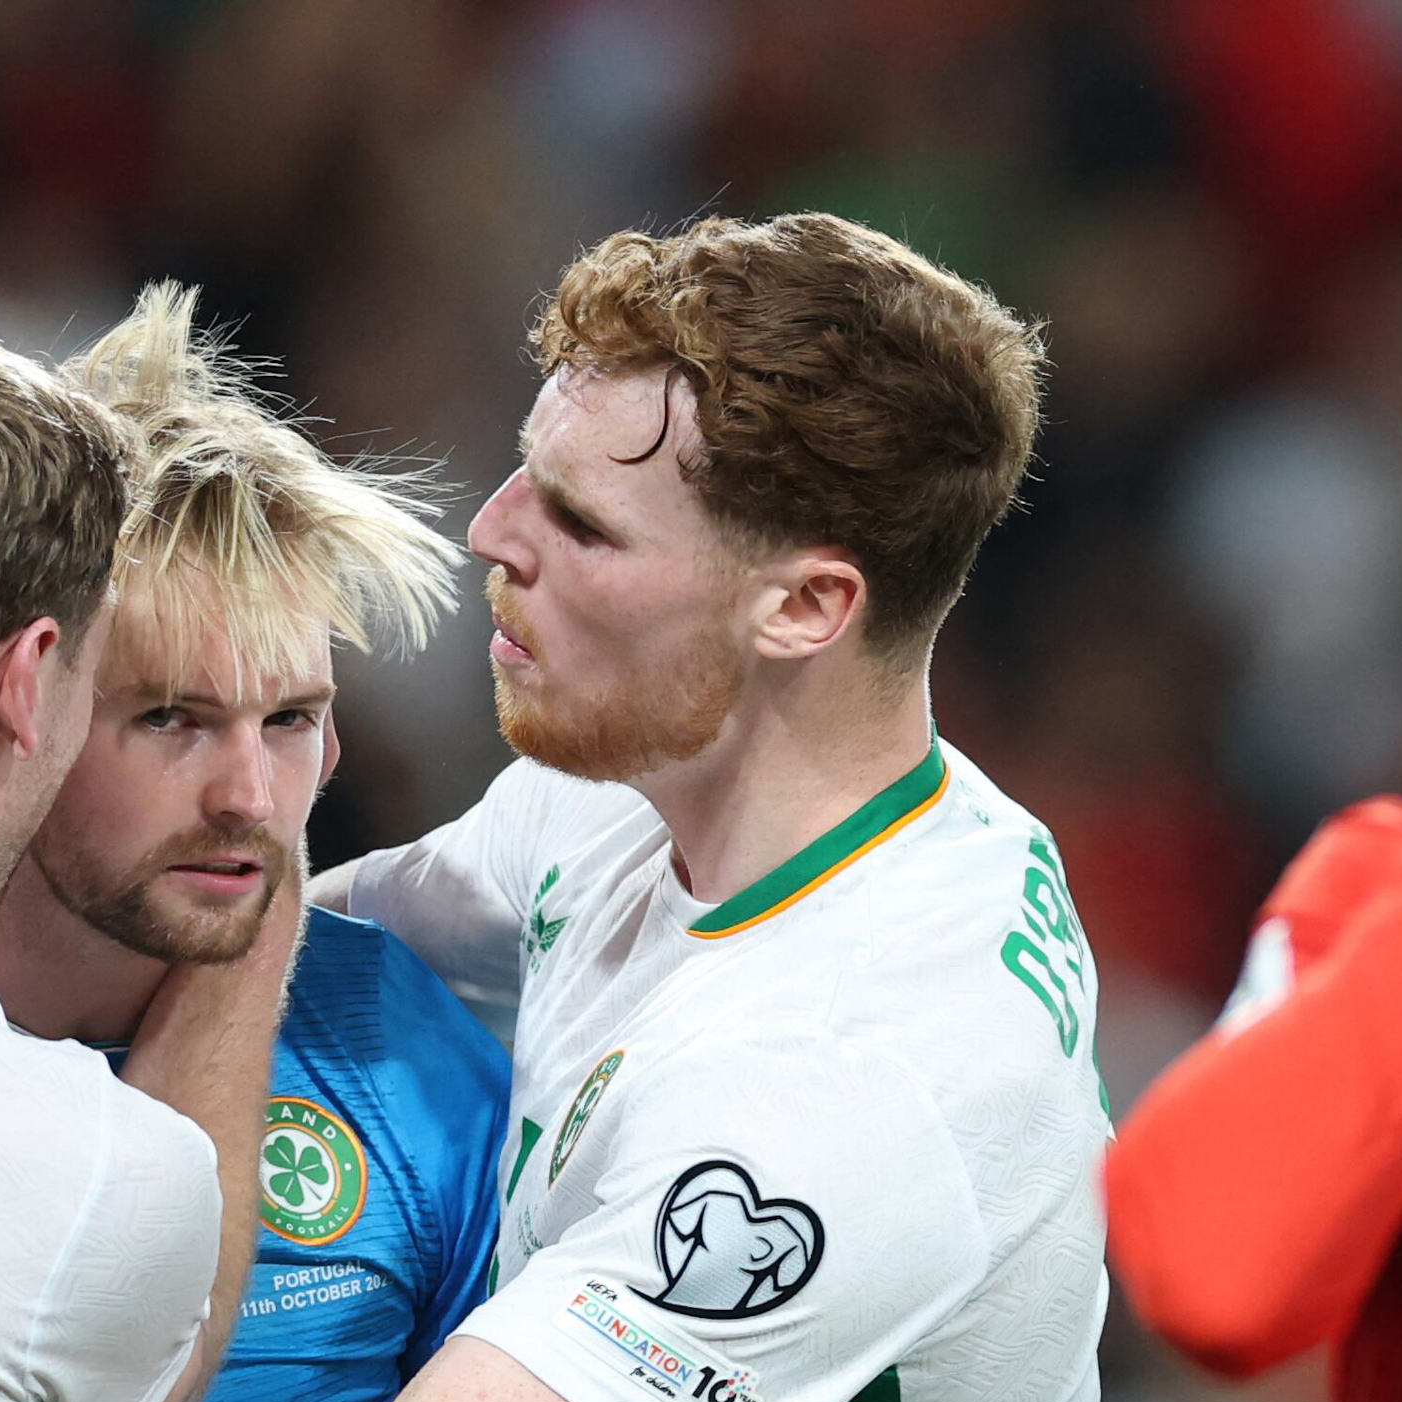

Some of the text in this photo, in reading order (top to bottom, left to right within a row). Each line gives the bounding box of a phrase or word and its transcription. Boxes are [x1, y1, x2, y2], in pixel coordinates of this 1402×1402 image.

[275, 1206, 350, 1236] FOOTBALL
[273, 1260, 366, 1291] PORTUGAL
[586, 1280, 618, 1301] UEFA
[240, 1298, 276, 1318] 11th
[281, 1280, 362, 1311] OCTOBER
